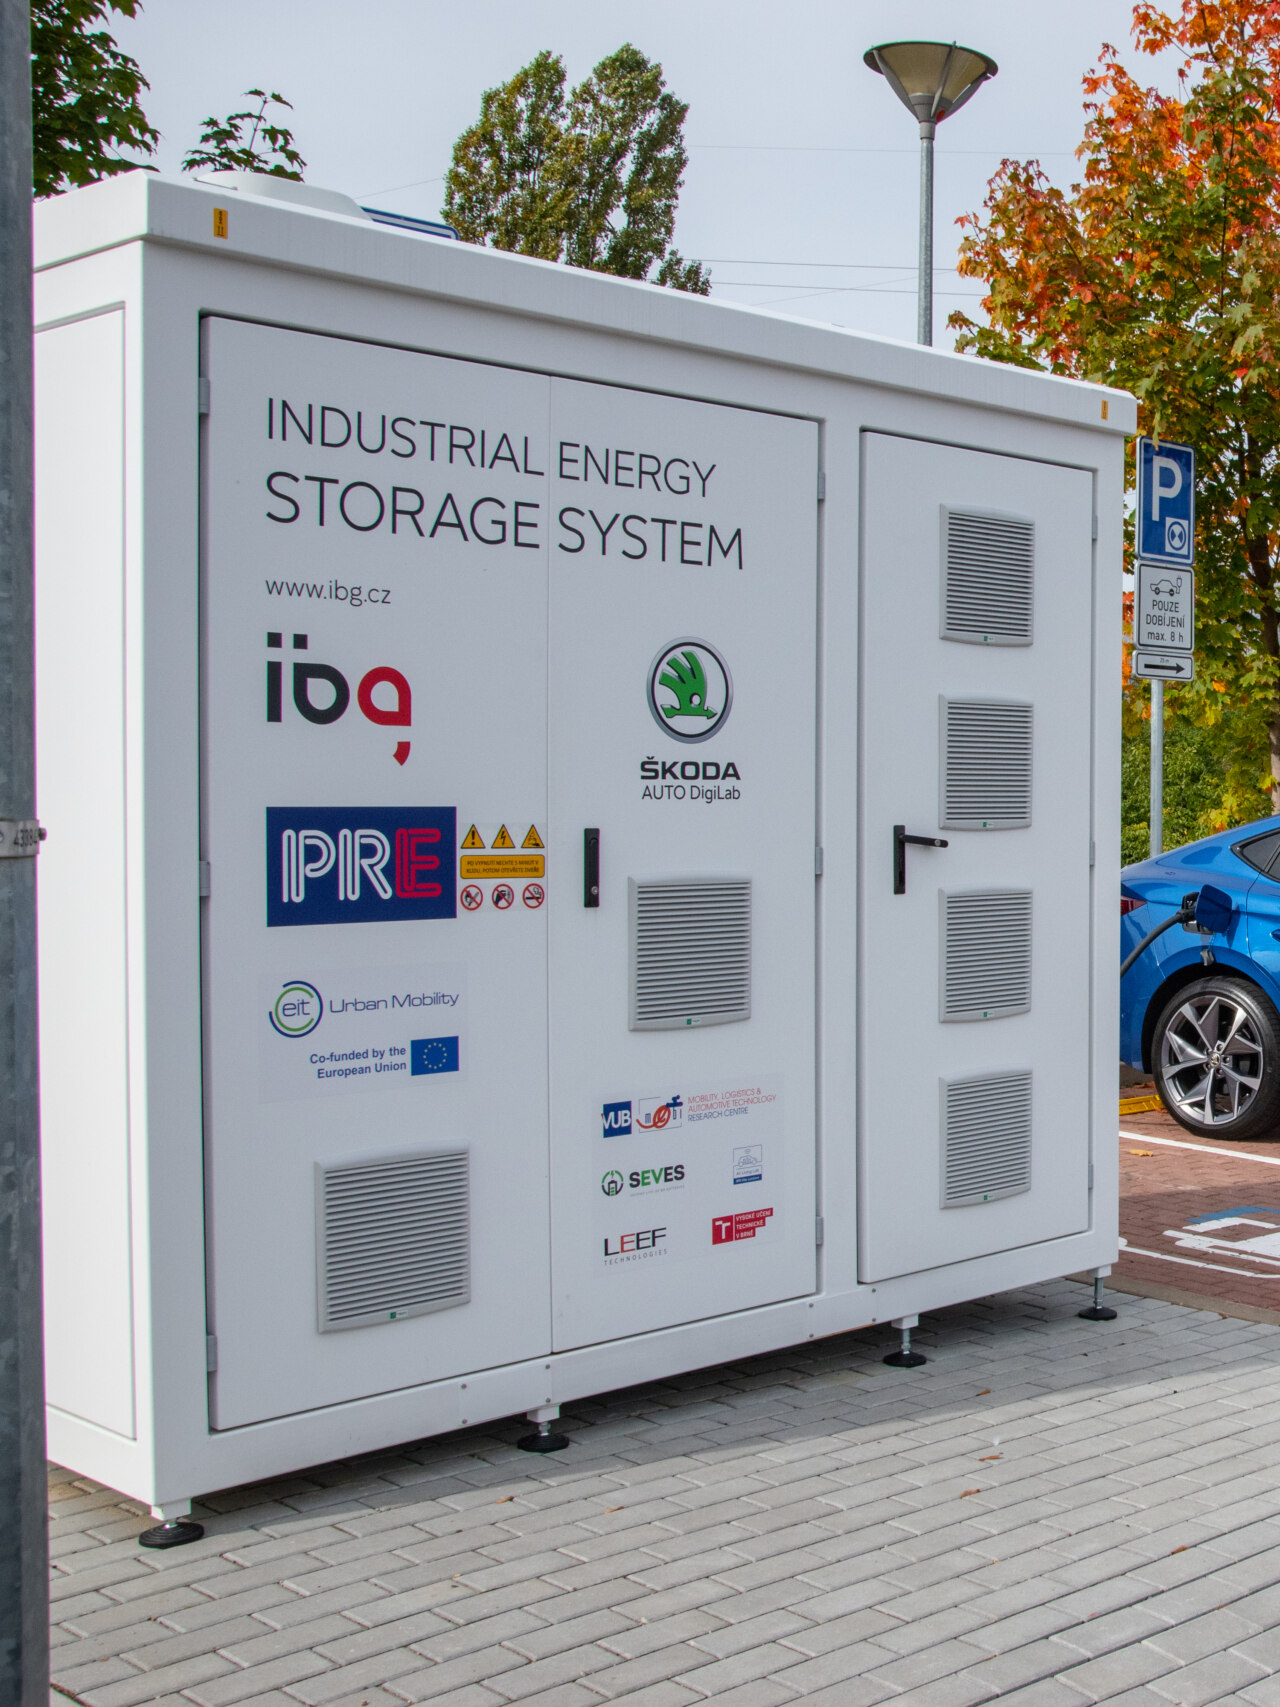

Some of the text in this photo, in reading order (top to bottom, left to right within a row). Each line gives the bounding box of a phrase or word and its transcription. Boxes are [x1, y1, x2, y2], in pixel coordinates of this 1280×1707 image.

[268, 397, 717, 498] INDUSTRIAL ENERGY
[1152, 455, 1183, 522] P
[265, 471, 744, 570] STORAGE SYSTEM
[265, 579, 392, 607] www.ibg.cz
[1152, 599, 1180, 613] POUZE
[1145, 613, 1185, 628] DOBÍJENÍ
[1147, 631, 1184, 643] max. 8 h
[640, 756, 742, 780] ŠKODA
[641, 785, 741, 804] AUTO DigiLab
[282, 828, 442, 903] PRE
[282, 992, 460, 1018] eit Urban Mobility
[309, 1046, 406, 1064] Co-funded by the
[317, 1062, 407, 1079] European Union
[687, 1094, 777, 1113] AUTOMOTIVE TECHNOLOGY
[721, 1088, 755, 1100] LOGISTICS
[601, 1110, 632, 1130] VUB
[687, 1106, 749, 1121] RESEARCH CENTRE
[629, 1164, 686, 1188] SEVES
[735, 1209, 771, 1222] VYSOKÉ UČENÍ
[735, 1219, 764, 1230] TECHNICKÉ
[604, 1227, 667, 1256] LEEF
[603, 1249, 668, 1266] TECHNOLOGIES
